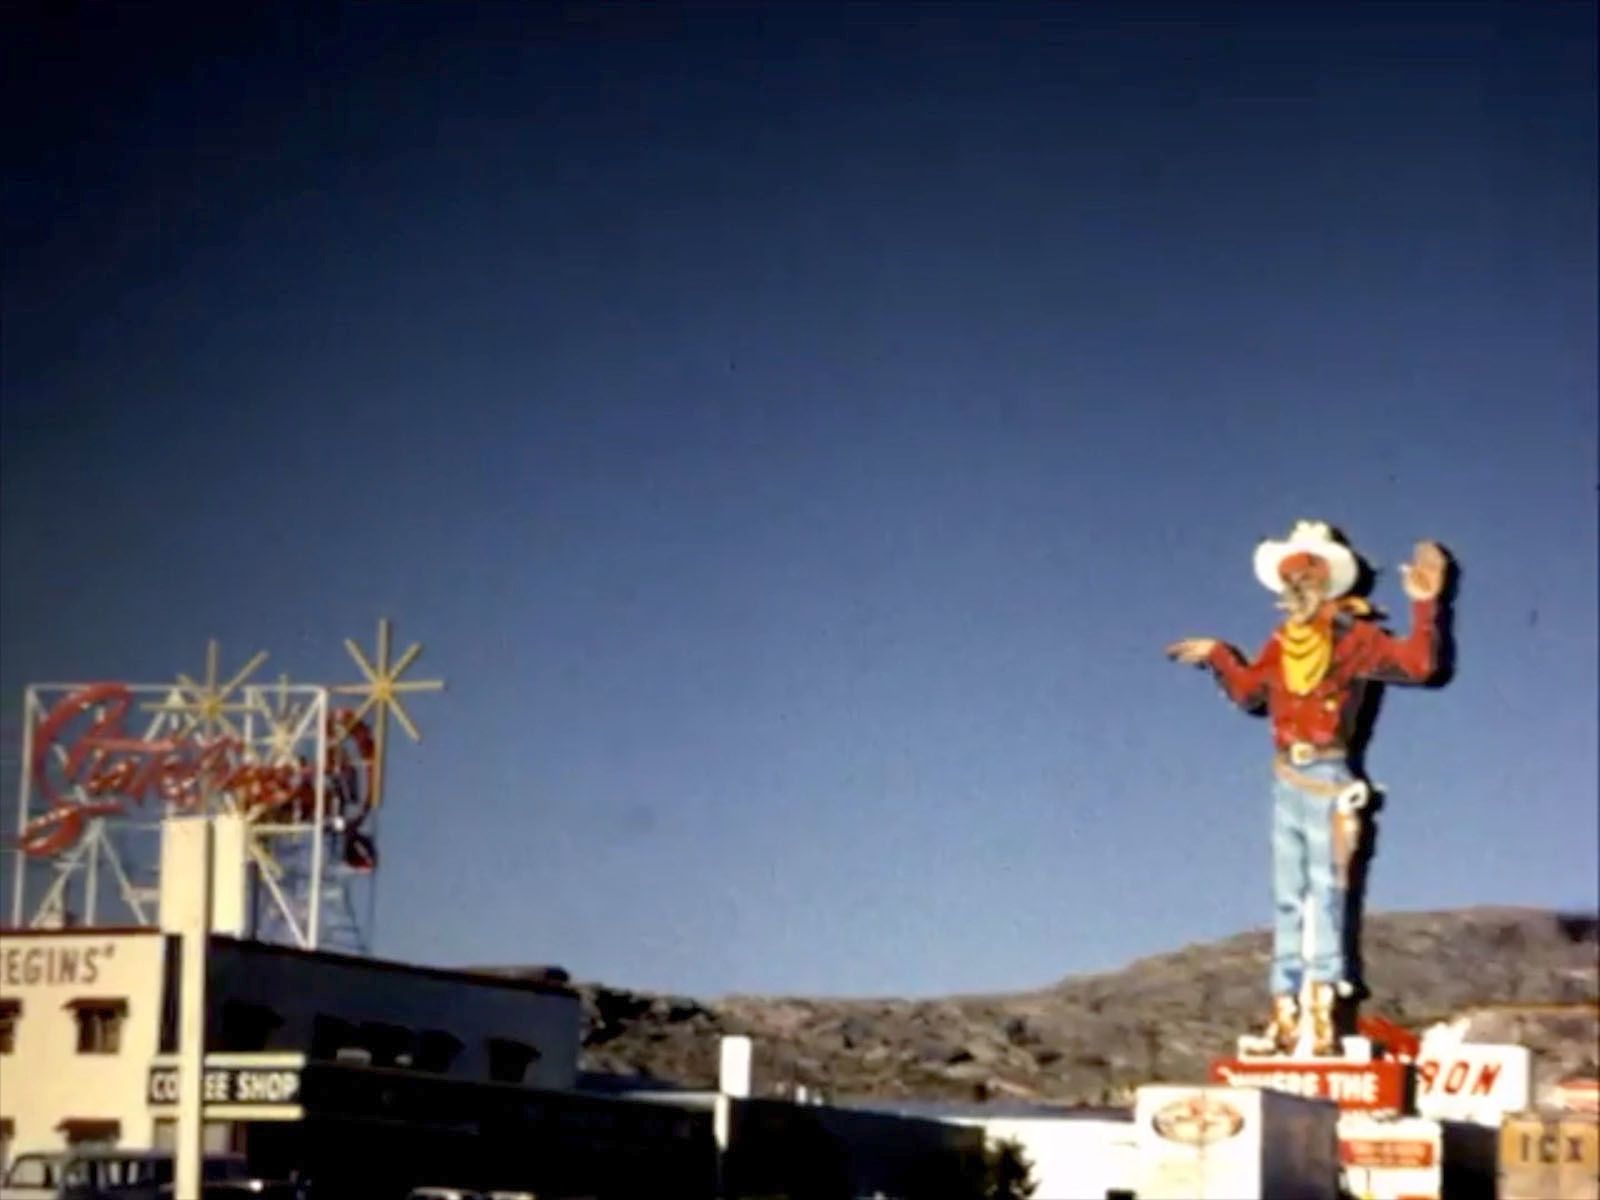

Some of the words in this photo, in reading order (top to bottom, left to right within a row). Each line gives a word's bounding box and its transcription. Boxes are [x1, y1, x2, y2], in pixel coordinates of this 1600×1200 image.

[151, 1071, 229, 1101] COEE
[236, 1071, 301, 1101] SHOP
[1327, 1071, 1379, 1104] THE
